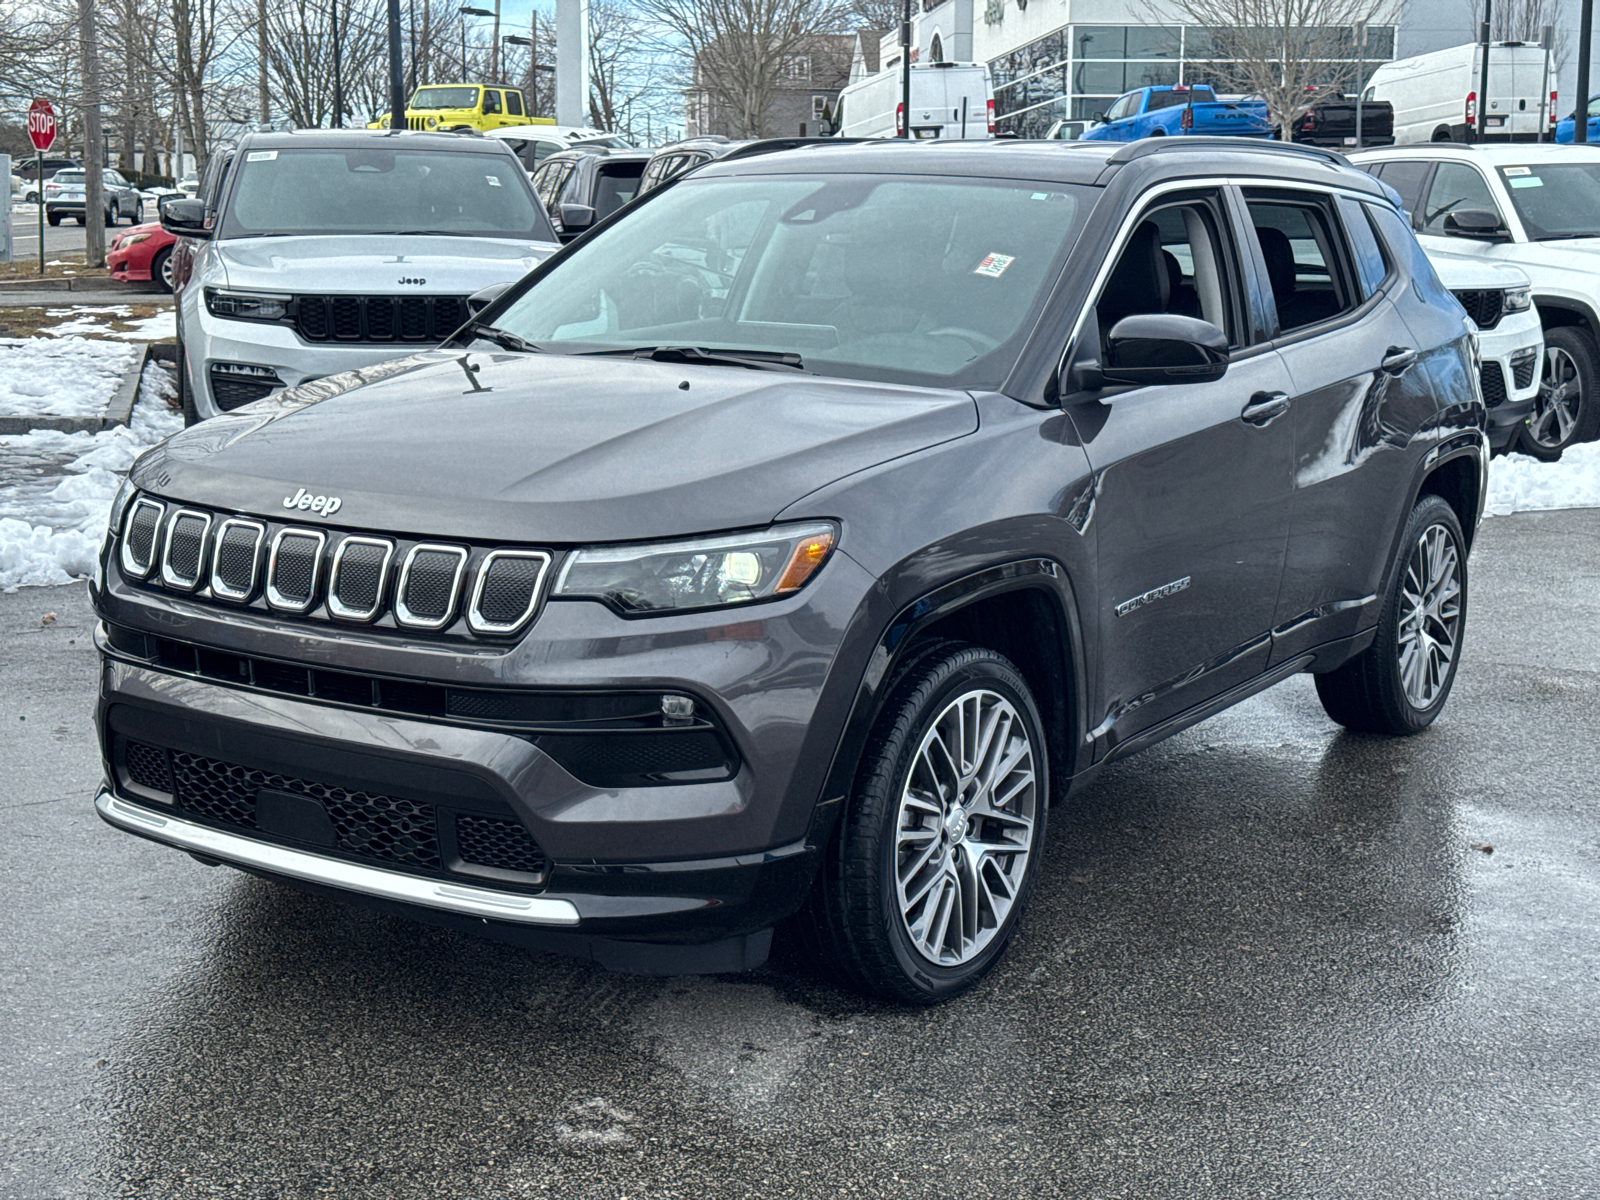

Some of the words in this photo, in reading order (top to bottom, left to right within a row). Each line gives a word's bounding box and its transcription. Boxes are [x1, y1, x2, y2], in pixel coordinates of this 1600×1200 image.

[29, 111, 54, 134] STOP
[397, 276, 427, 286] Jeep
[282, 487, 342, 518] Jeep
[1114, 575, 1191, 617] COMPASS
